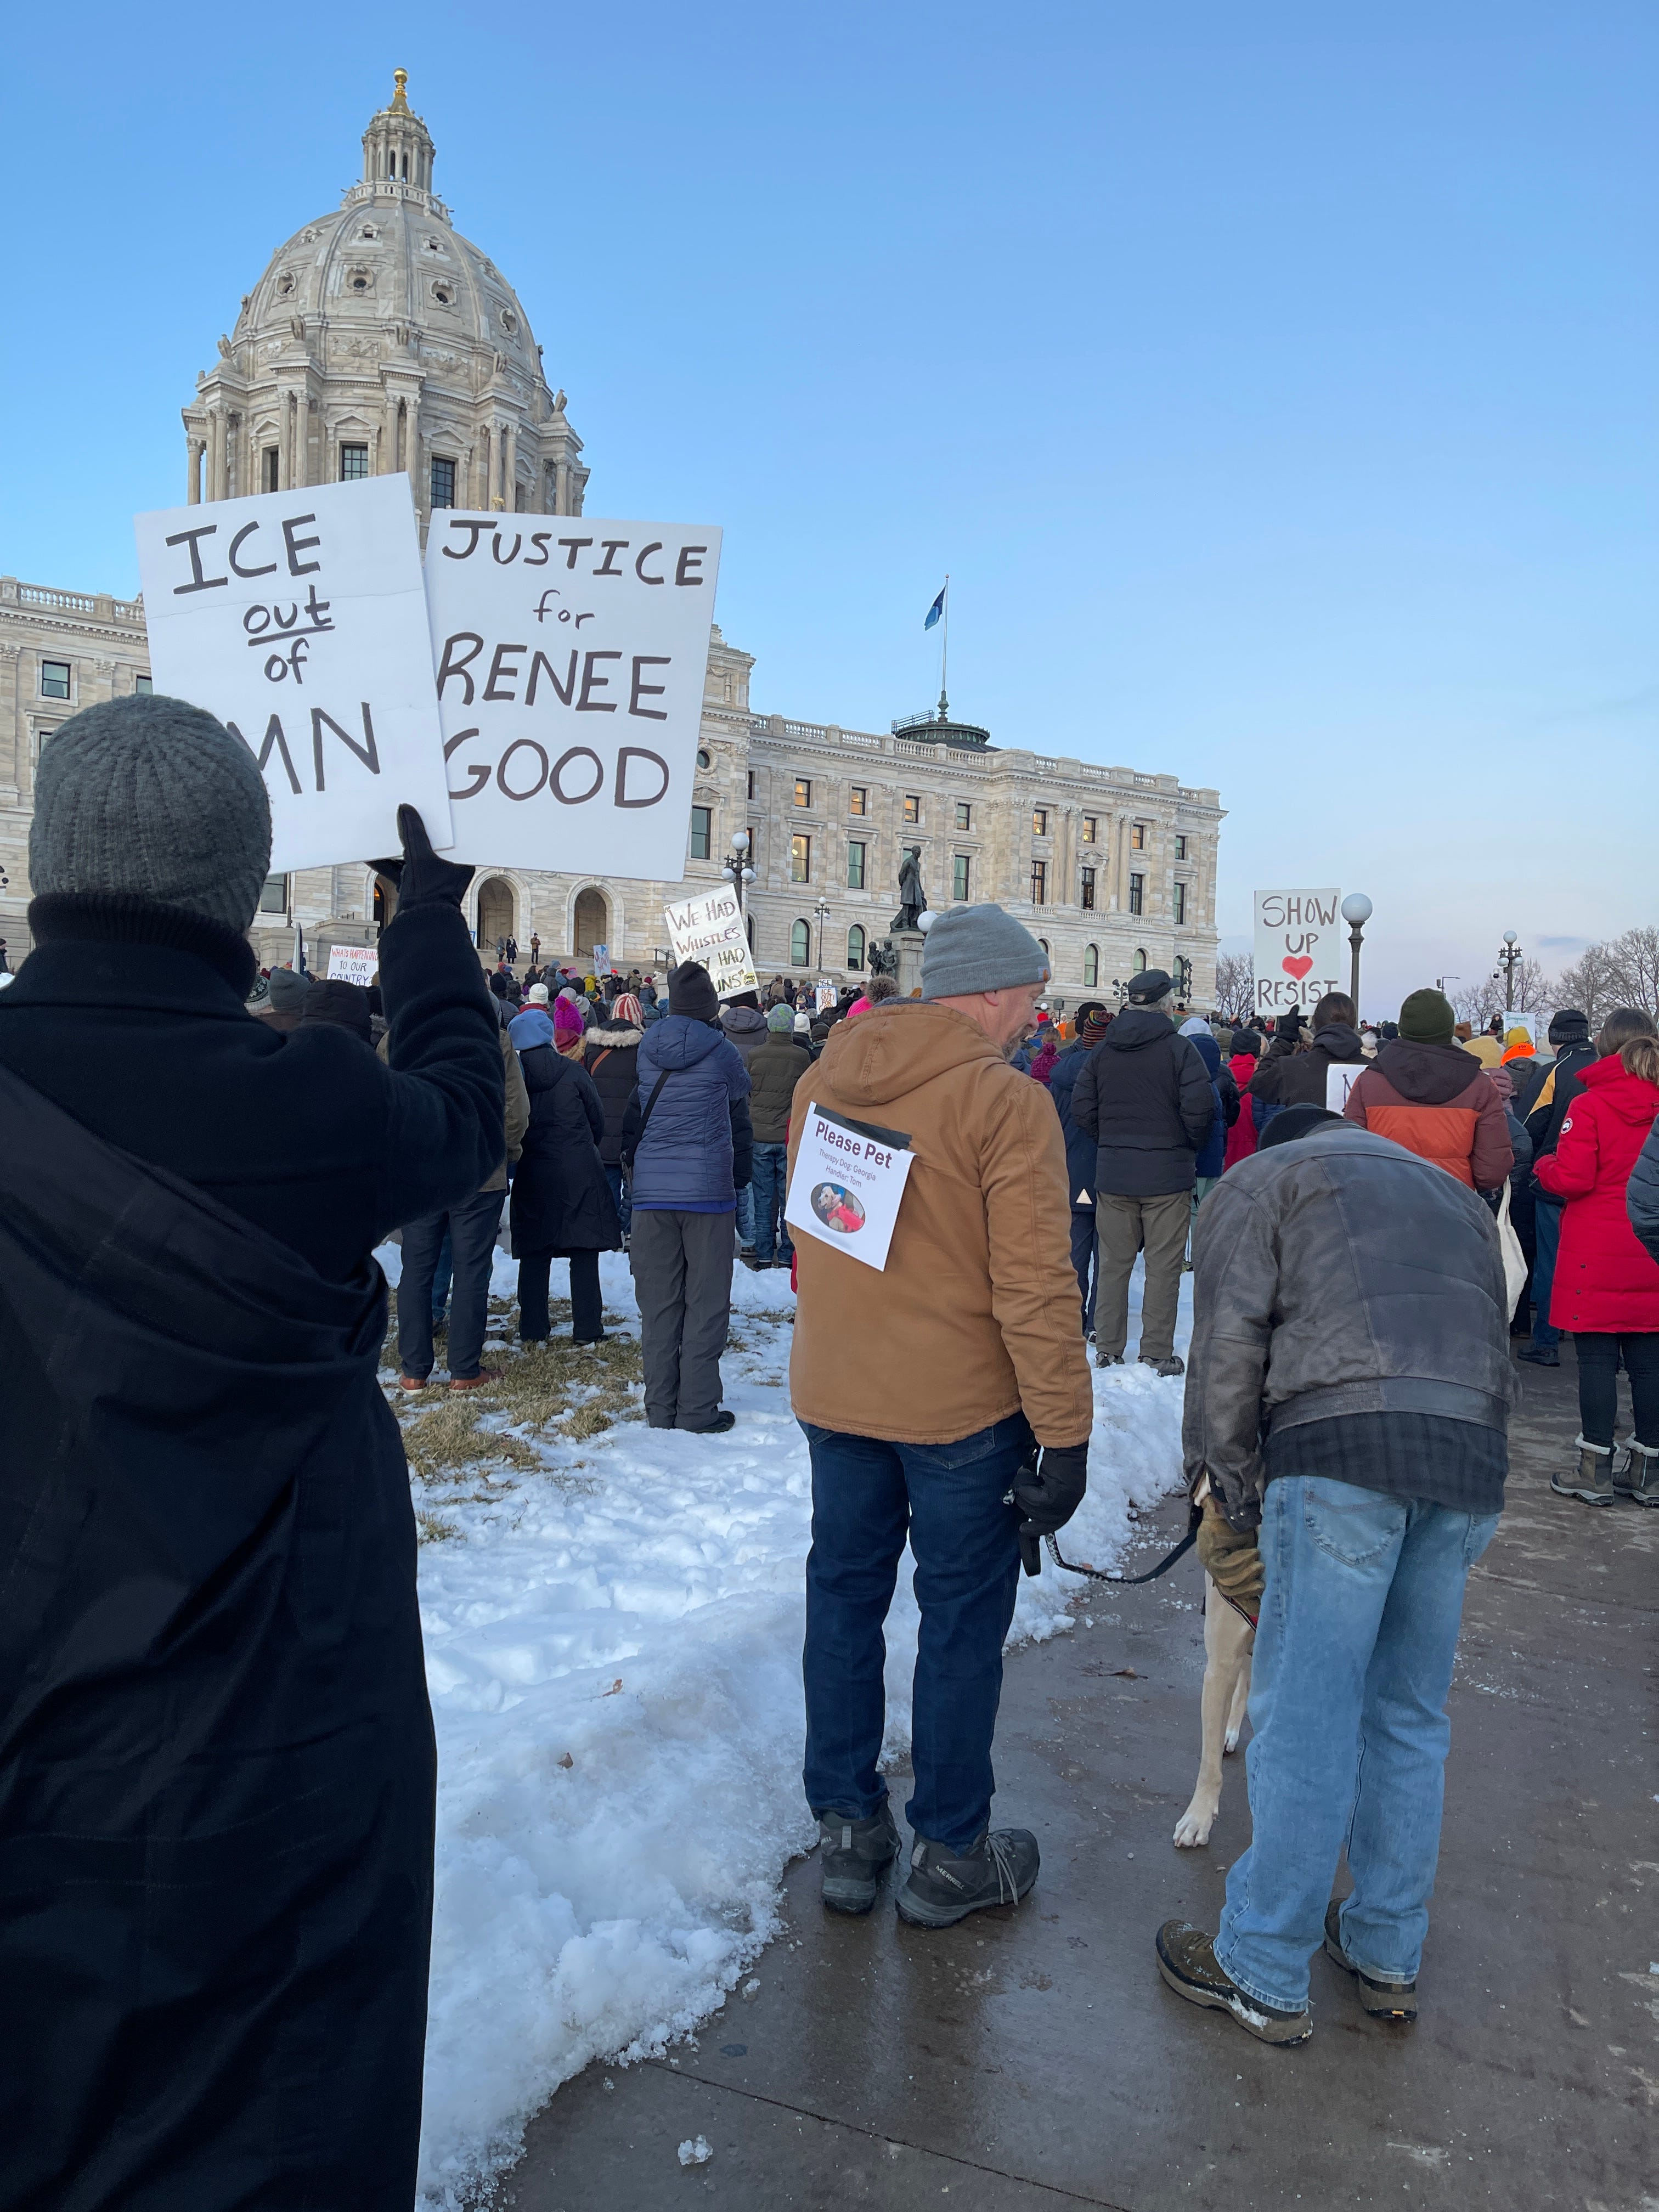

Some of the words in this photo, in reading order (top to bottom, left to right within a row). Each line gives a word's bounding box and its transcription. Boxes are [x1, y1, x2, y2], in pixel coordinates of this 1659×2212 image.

[165, 513, 321, 594] ICE
[442, 520, 707, 586] JUSTICE
[243, 584, 331, 635] out
[532, 589, 595, 630] for
[264, 637, 310, 684] of
[438, 632, 671, 720] RENEE
[226, 702, 380, 794] MN
[444, 727, 669, 808] GOOD
[706, 899, 735, 921] HAD
[1262, 895, 1338, 927] SHOW
[349, 949, 378, 961] HAPPENING
[676, 927, 741, 955] WHISTLES
[718, 948, 745, 966] HAD
[1285, 933, 1319, 954] UP
[340, 960, 347, 969] TO
[351, 962, 367, 972] OUR
[1259, 979, 1338, 1008] RESIST
[815, 1121, 861, 1155] Please
[865, 1143, 892, 1169] Pet
[819, 1148, 839, 1165] Therapy
[839, 1159, 853, 1171] Dog:
[853, 1165, 876, 1181] Georgia
[826, 1165, 849, 1182] Handler:
[850, 1176, 862, 1188] Tom
[935, 1865, 964, 1890] MERRELL
